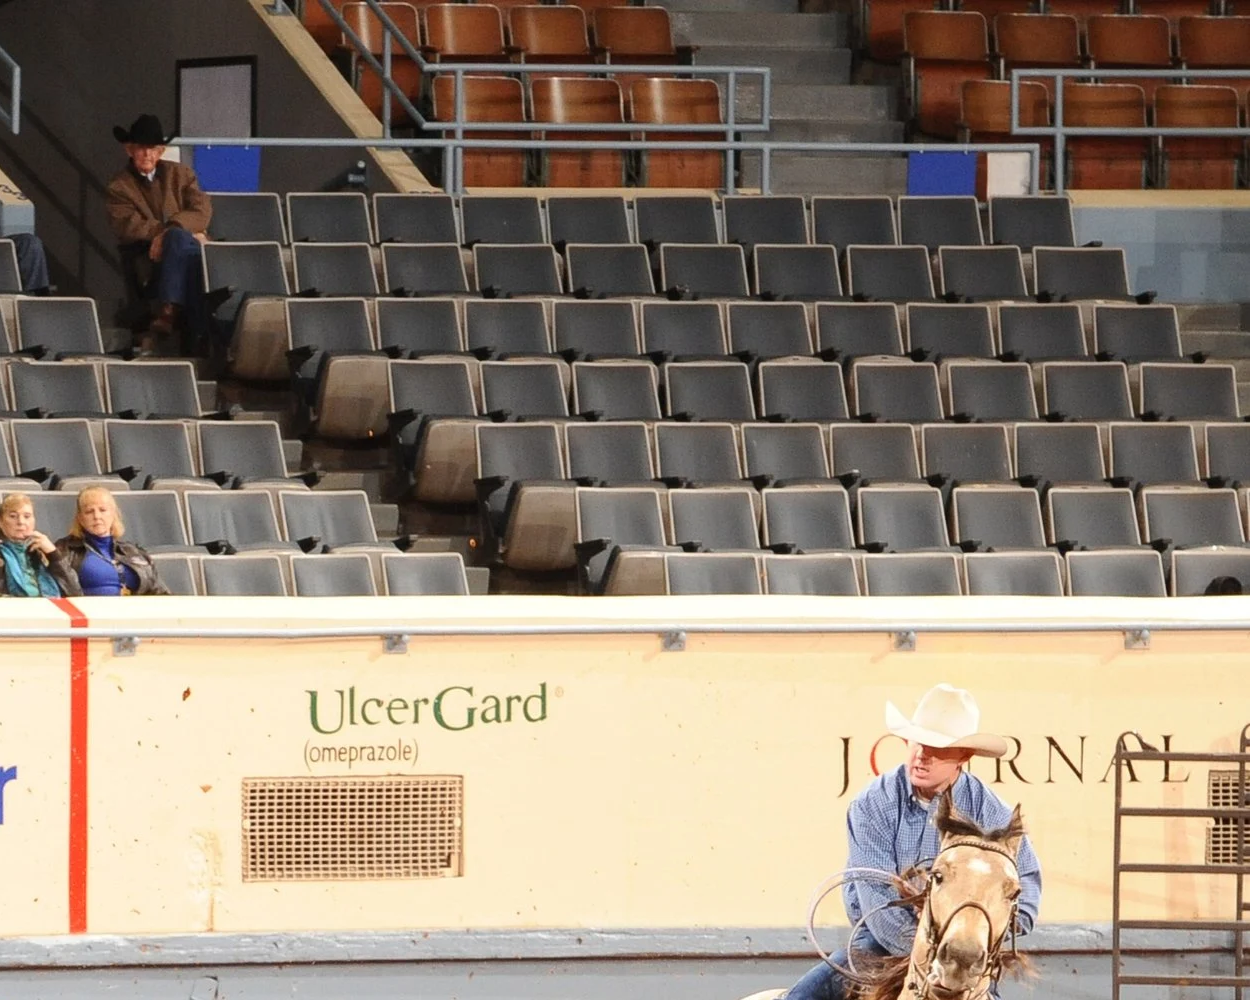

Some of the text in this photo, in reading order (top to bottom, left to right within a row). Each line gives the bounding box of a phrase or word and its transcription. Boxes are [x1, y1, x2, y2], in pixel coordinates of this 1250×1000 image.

[305, 682, 547, 734] UlcerGard
[304, 738, 419, 771] (omeprazole)
[837, 733, 1190, 798] JRNAL
